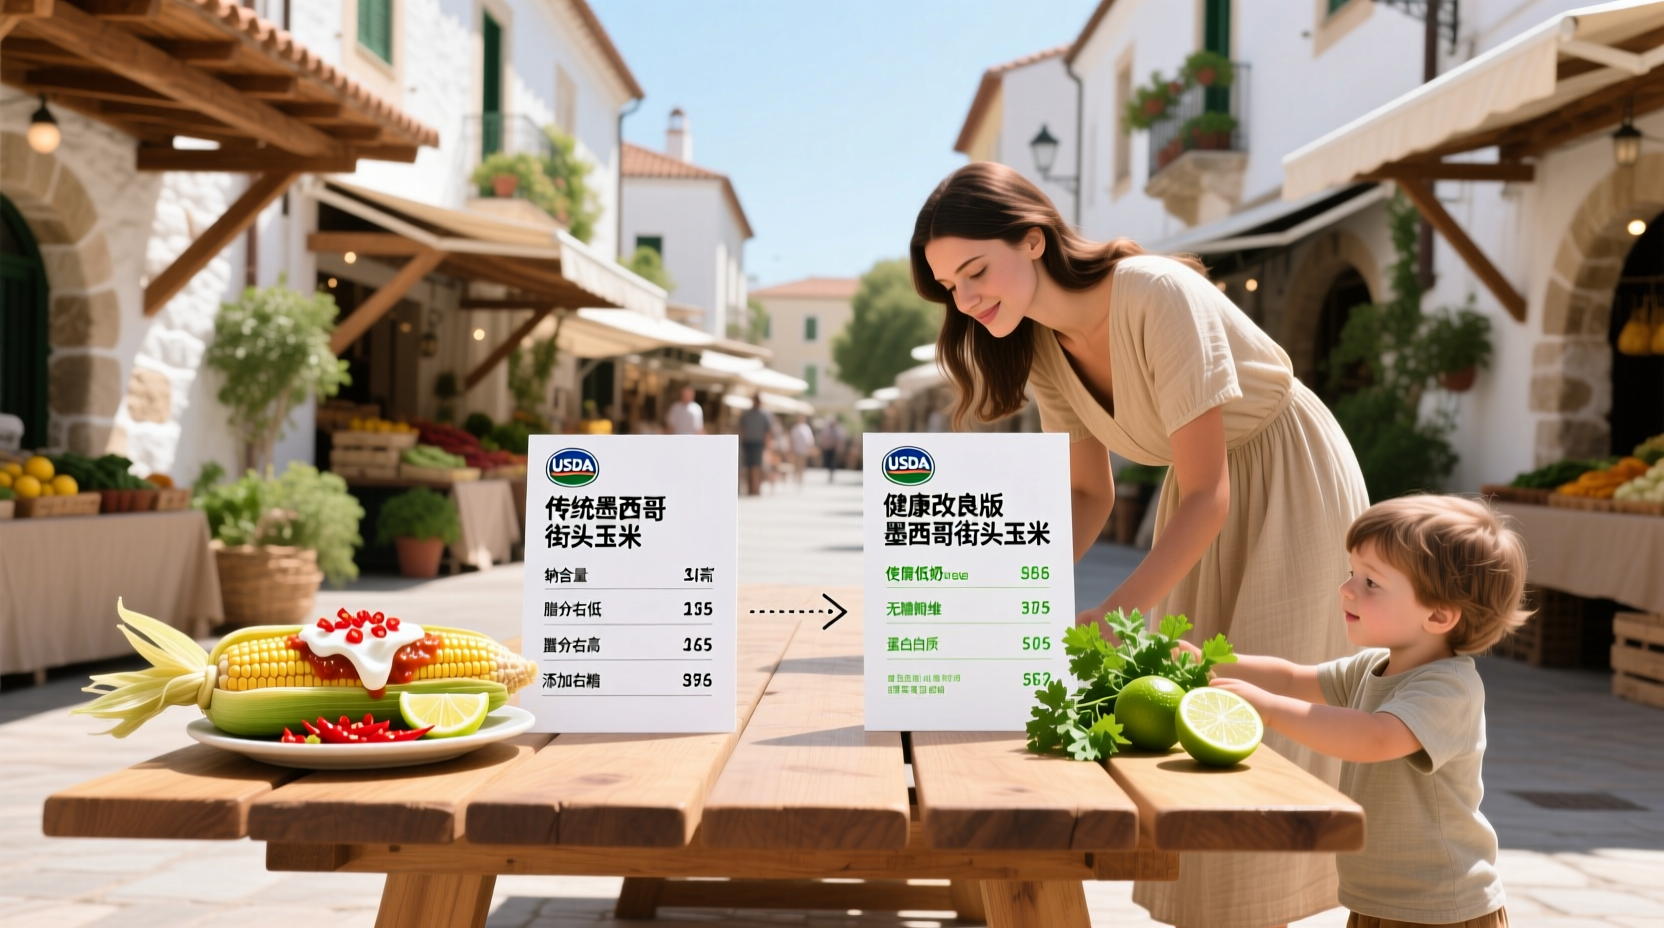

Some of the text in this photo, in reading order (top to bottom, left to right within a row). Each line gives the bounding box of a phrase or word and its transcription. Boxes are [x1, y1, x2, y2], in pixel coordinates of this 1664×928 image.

[552, 458, 594, 472] USDA
[888, 456, 930, 470] USDA
[545, 495, 667, 522] 传统墨西哥
[883, 492, 1004, 518] 健康改良版
[545, 523, 643, 549] 街头玉米
[884, 519, 1051, 547] 墨西哥街头玉米
[1022, 637, 1051, 650] 505
